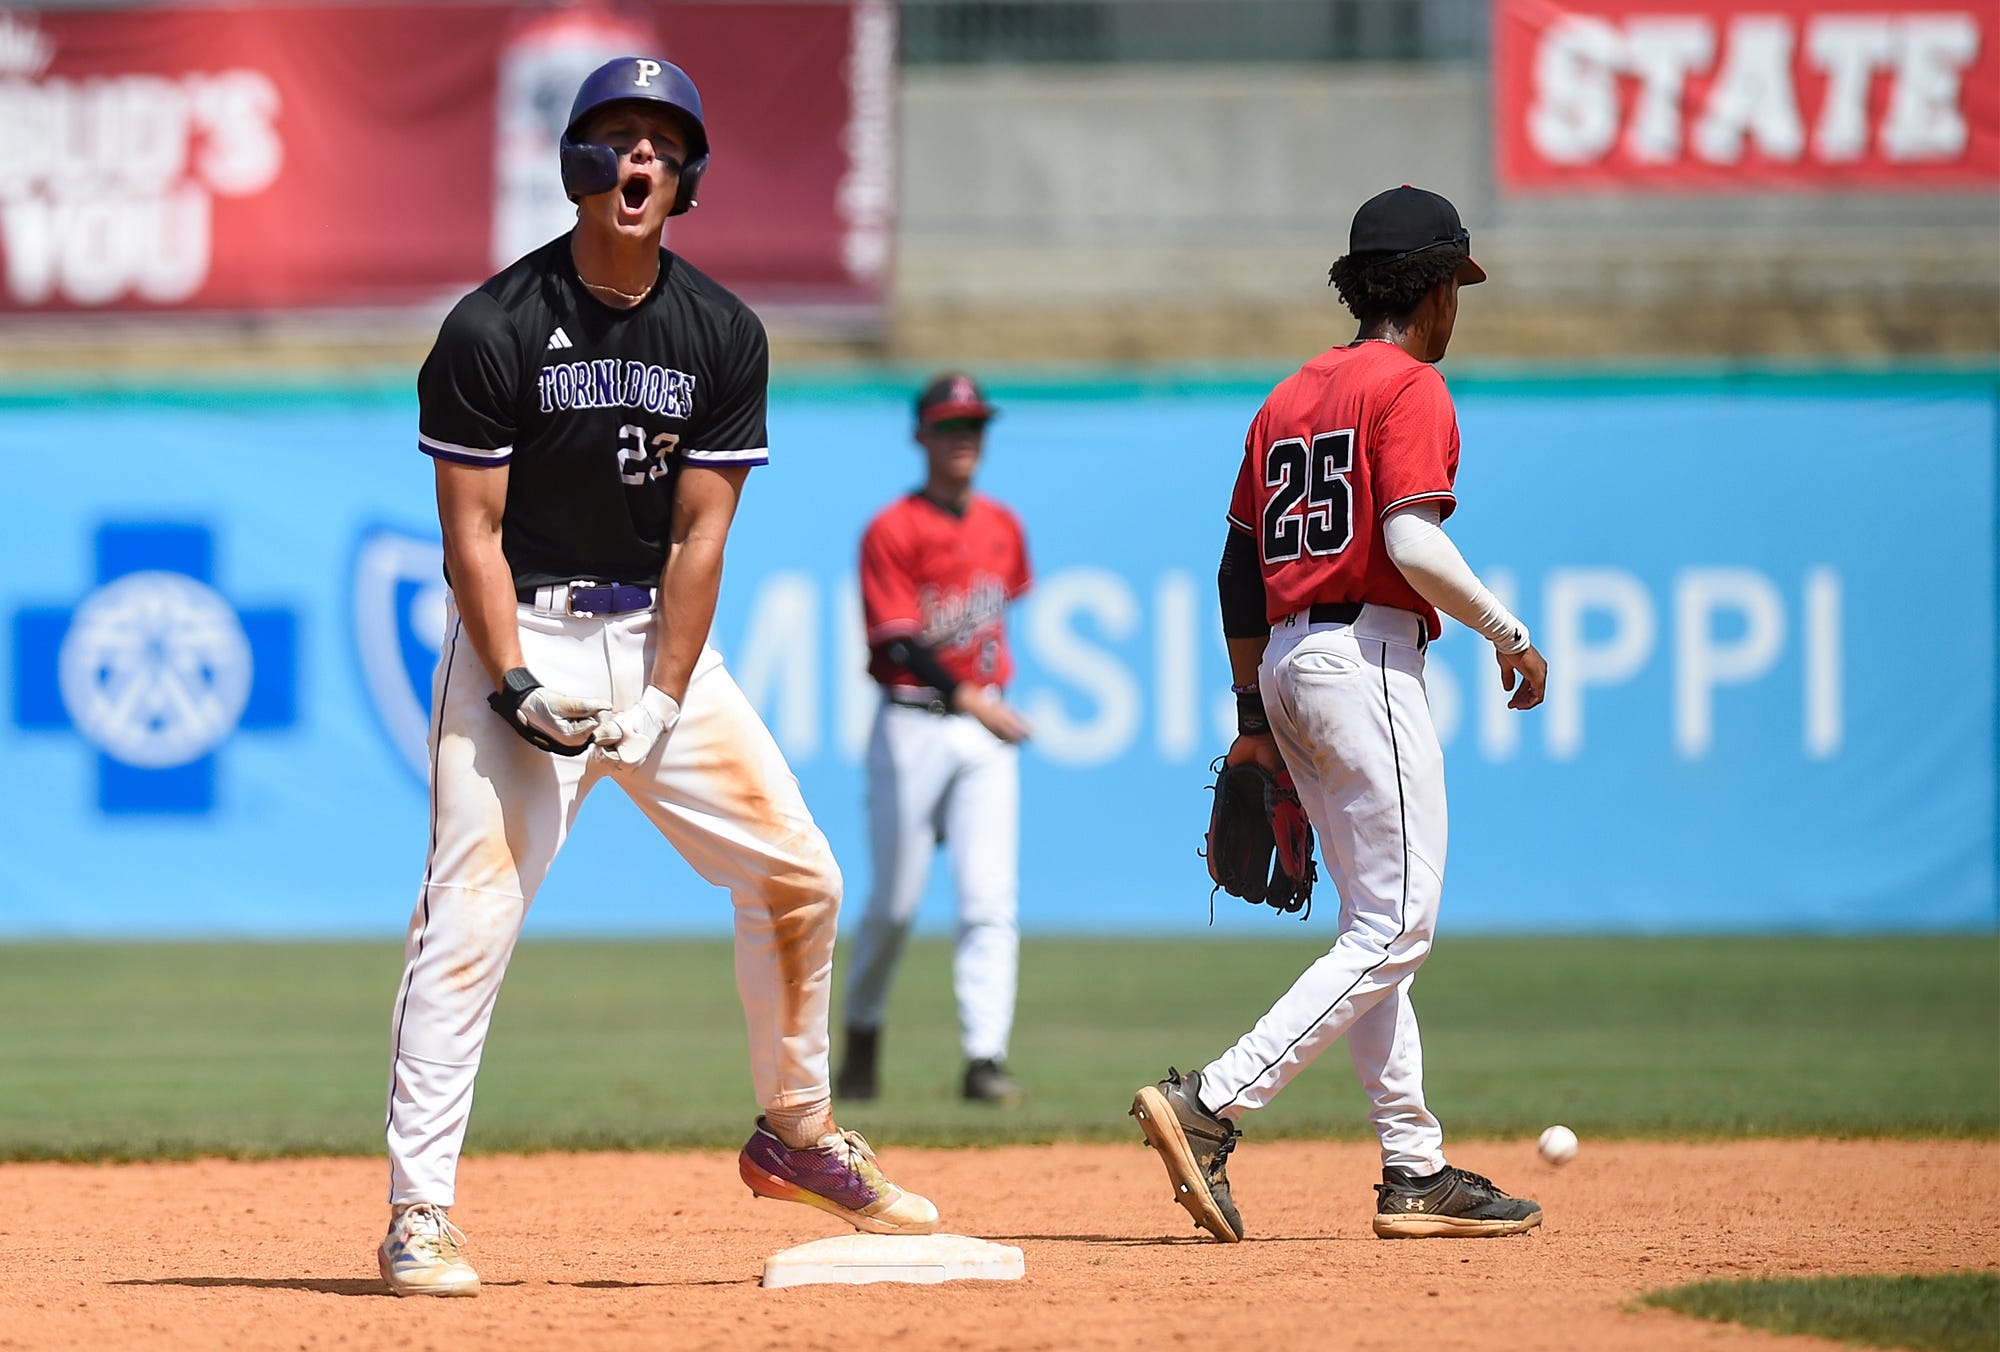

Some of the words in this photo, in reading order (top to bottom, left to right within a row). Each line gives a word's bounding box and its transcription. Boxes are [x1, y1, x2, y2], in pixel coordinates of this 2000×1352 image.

[634, 59, 662, 87] P
[1529, 15, 1979, 163] STATE
[5, 194, 211, 304] YOU
[538, 359, 696, 420] TORNDOES
[617, 424, 680, 485] 23
[1263, 428, 1354, 565] 25
[708, 568, 1841, 763] ISIIPPI
